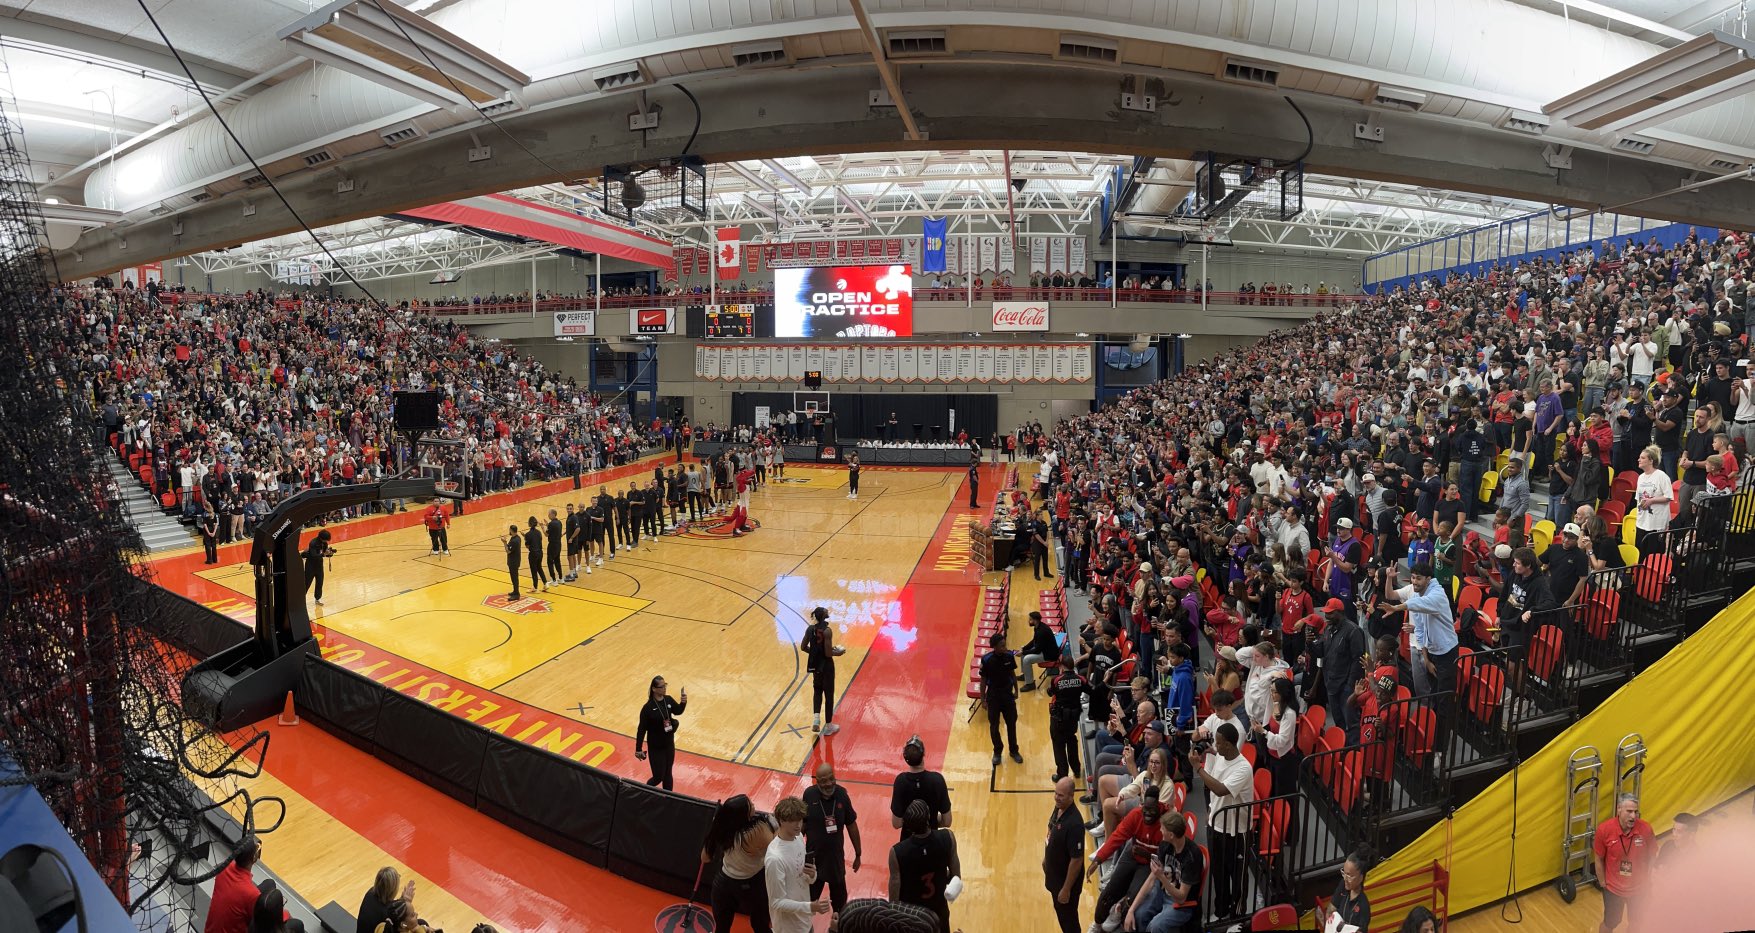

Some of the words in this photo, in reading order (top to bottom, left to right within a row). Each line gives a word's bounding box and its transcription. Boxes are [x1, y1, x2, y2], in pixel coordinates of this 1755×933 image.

[812, 292, 872, 304] OPEN
[724, 305, 739, 313] 5:00
[801, 304, 900, 316] RACTICE
[567, 312, 591, 321] PERFECT
[933, 554, 970, 571] GYM
[355, 660, 617, 768] UNIVERSITY
[921, 872, 936, 899] 3
